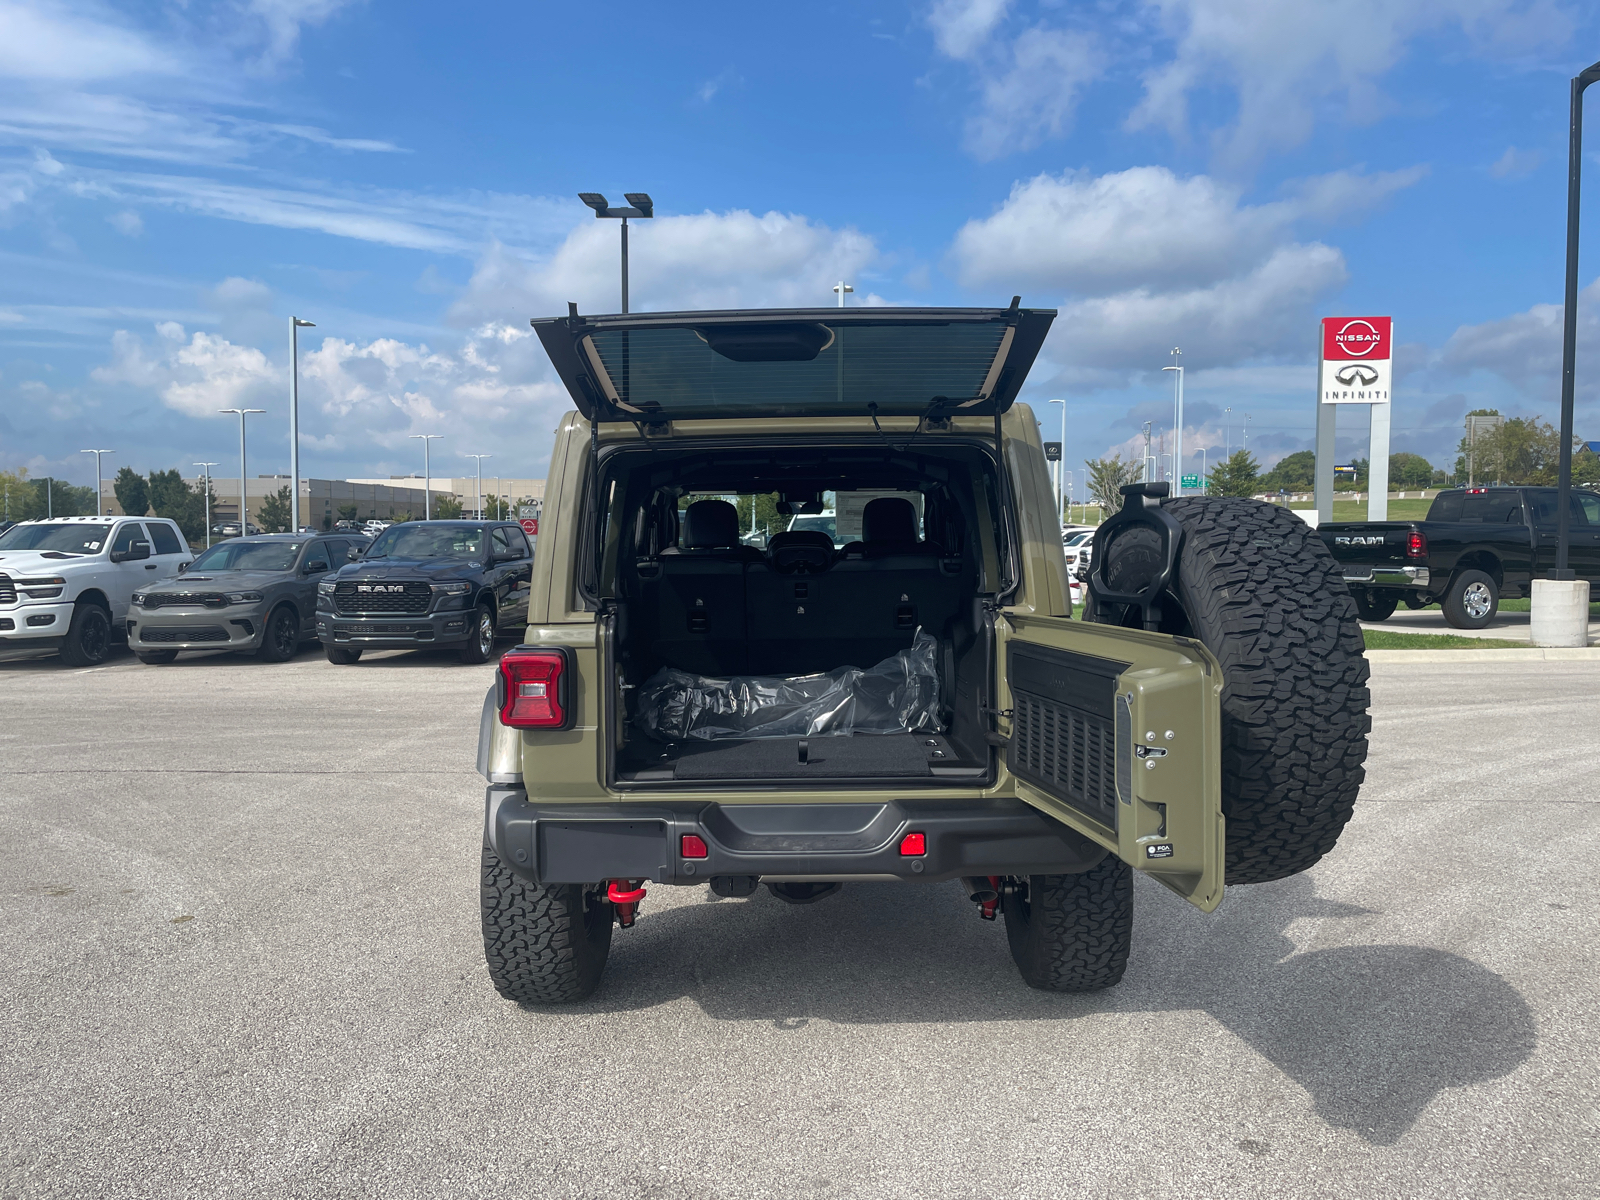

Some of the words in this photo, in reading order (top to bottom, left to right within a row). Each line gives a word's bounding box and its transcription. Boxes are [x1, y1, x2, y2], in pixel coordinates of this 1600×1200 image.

[1335, 334, 1381, 342] NISSAN
[1325, 390, 1388, 400] INFINITI
[1334, 536, 1385, 546] RAM
[357, 585, 404, 593] RAM
